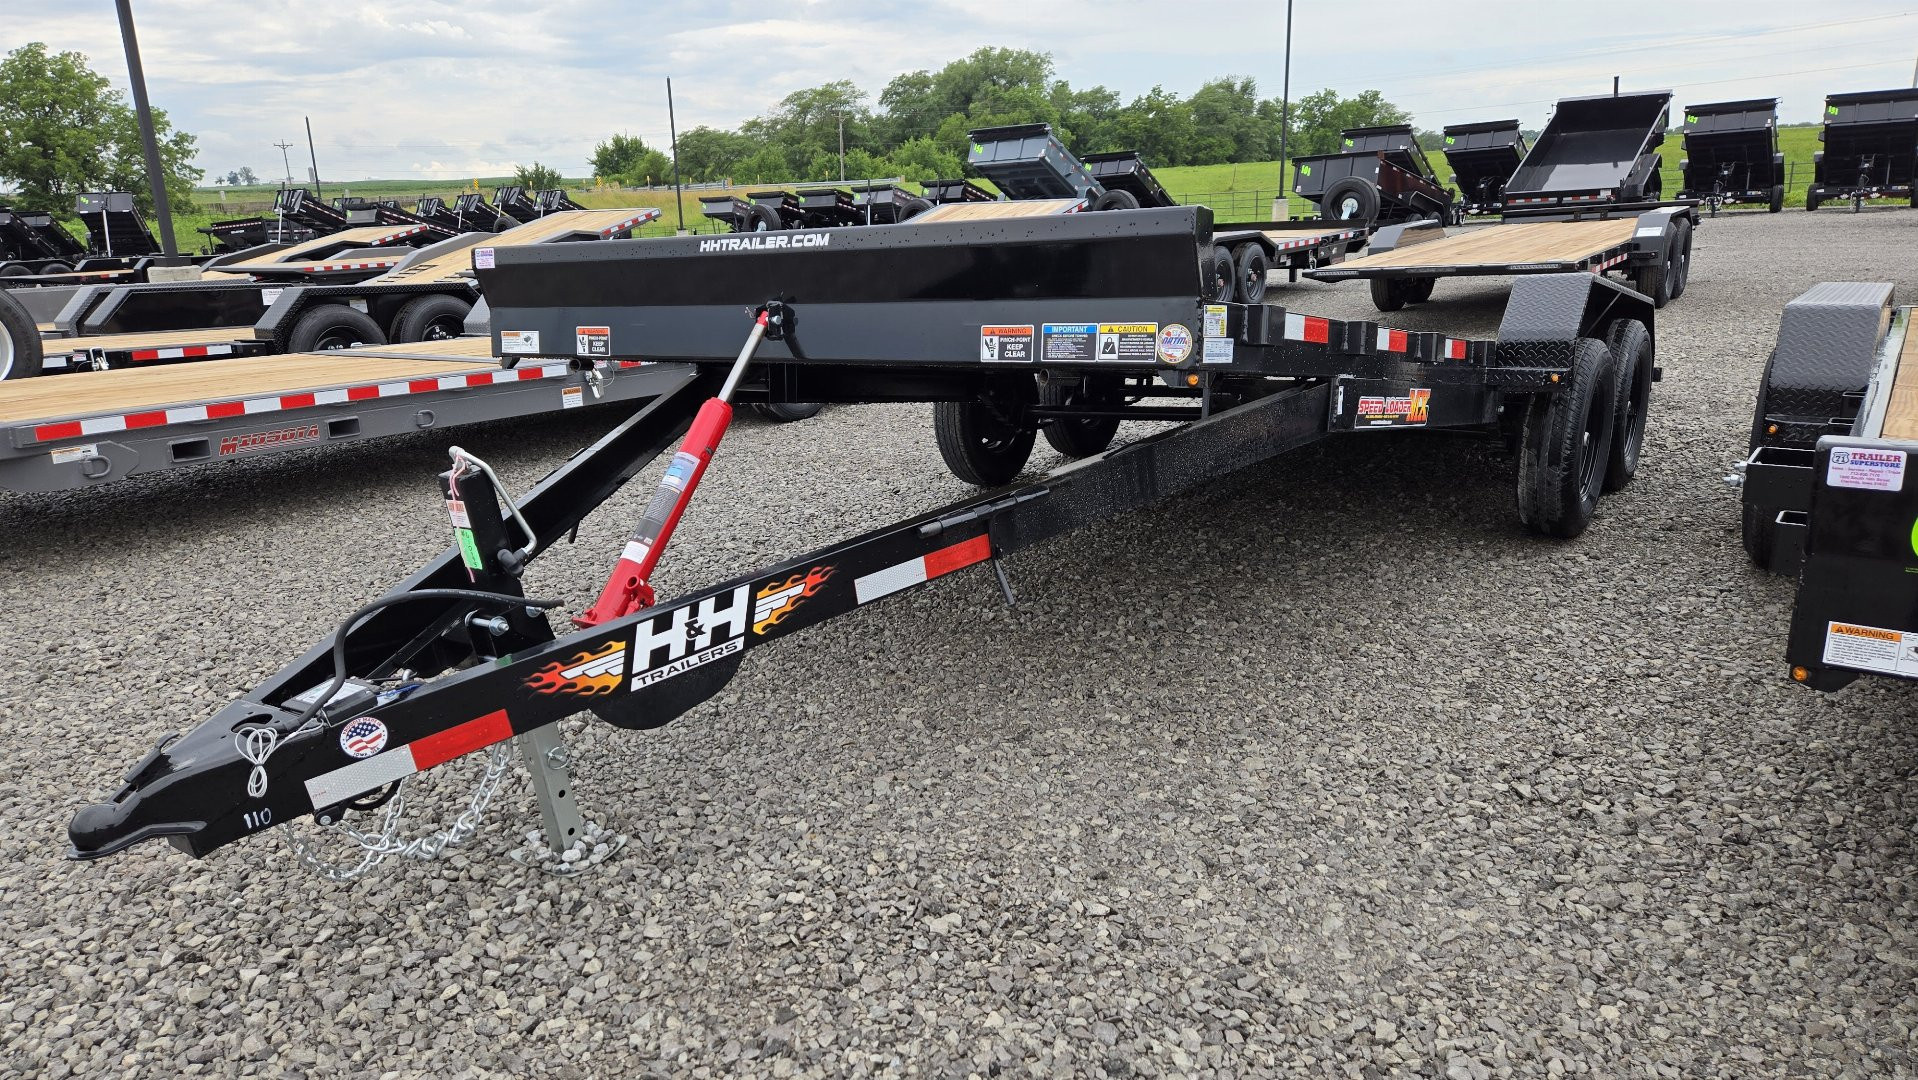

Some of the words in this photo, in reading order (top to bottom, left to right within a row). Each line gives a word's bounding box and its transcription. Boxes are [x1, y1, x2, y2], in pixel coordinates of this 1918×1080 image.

[699, 232, 830, 252] HHTRAILER.COM
[998, 327, 1027, 335] WARNING
[1051, 325, 1088, 333] IMPORTANT
[1006, 343, 1024, 351] KEEP
[1004, 350, 1025, 358] CLEAR
[219, 424, 320, 456] MIDSOTA
[1851, 452, 1902, 463] TRAILER
[1849, 460, 1901, 469] SUPERSTORE
[632, 584, 750, 674] H&H
[1845, 627, 1894, 640] WARNING
[638, 641, 738, 686] TRAILERS
[243, 807, 272, 829] 110
